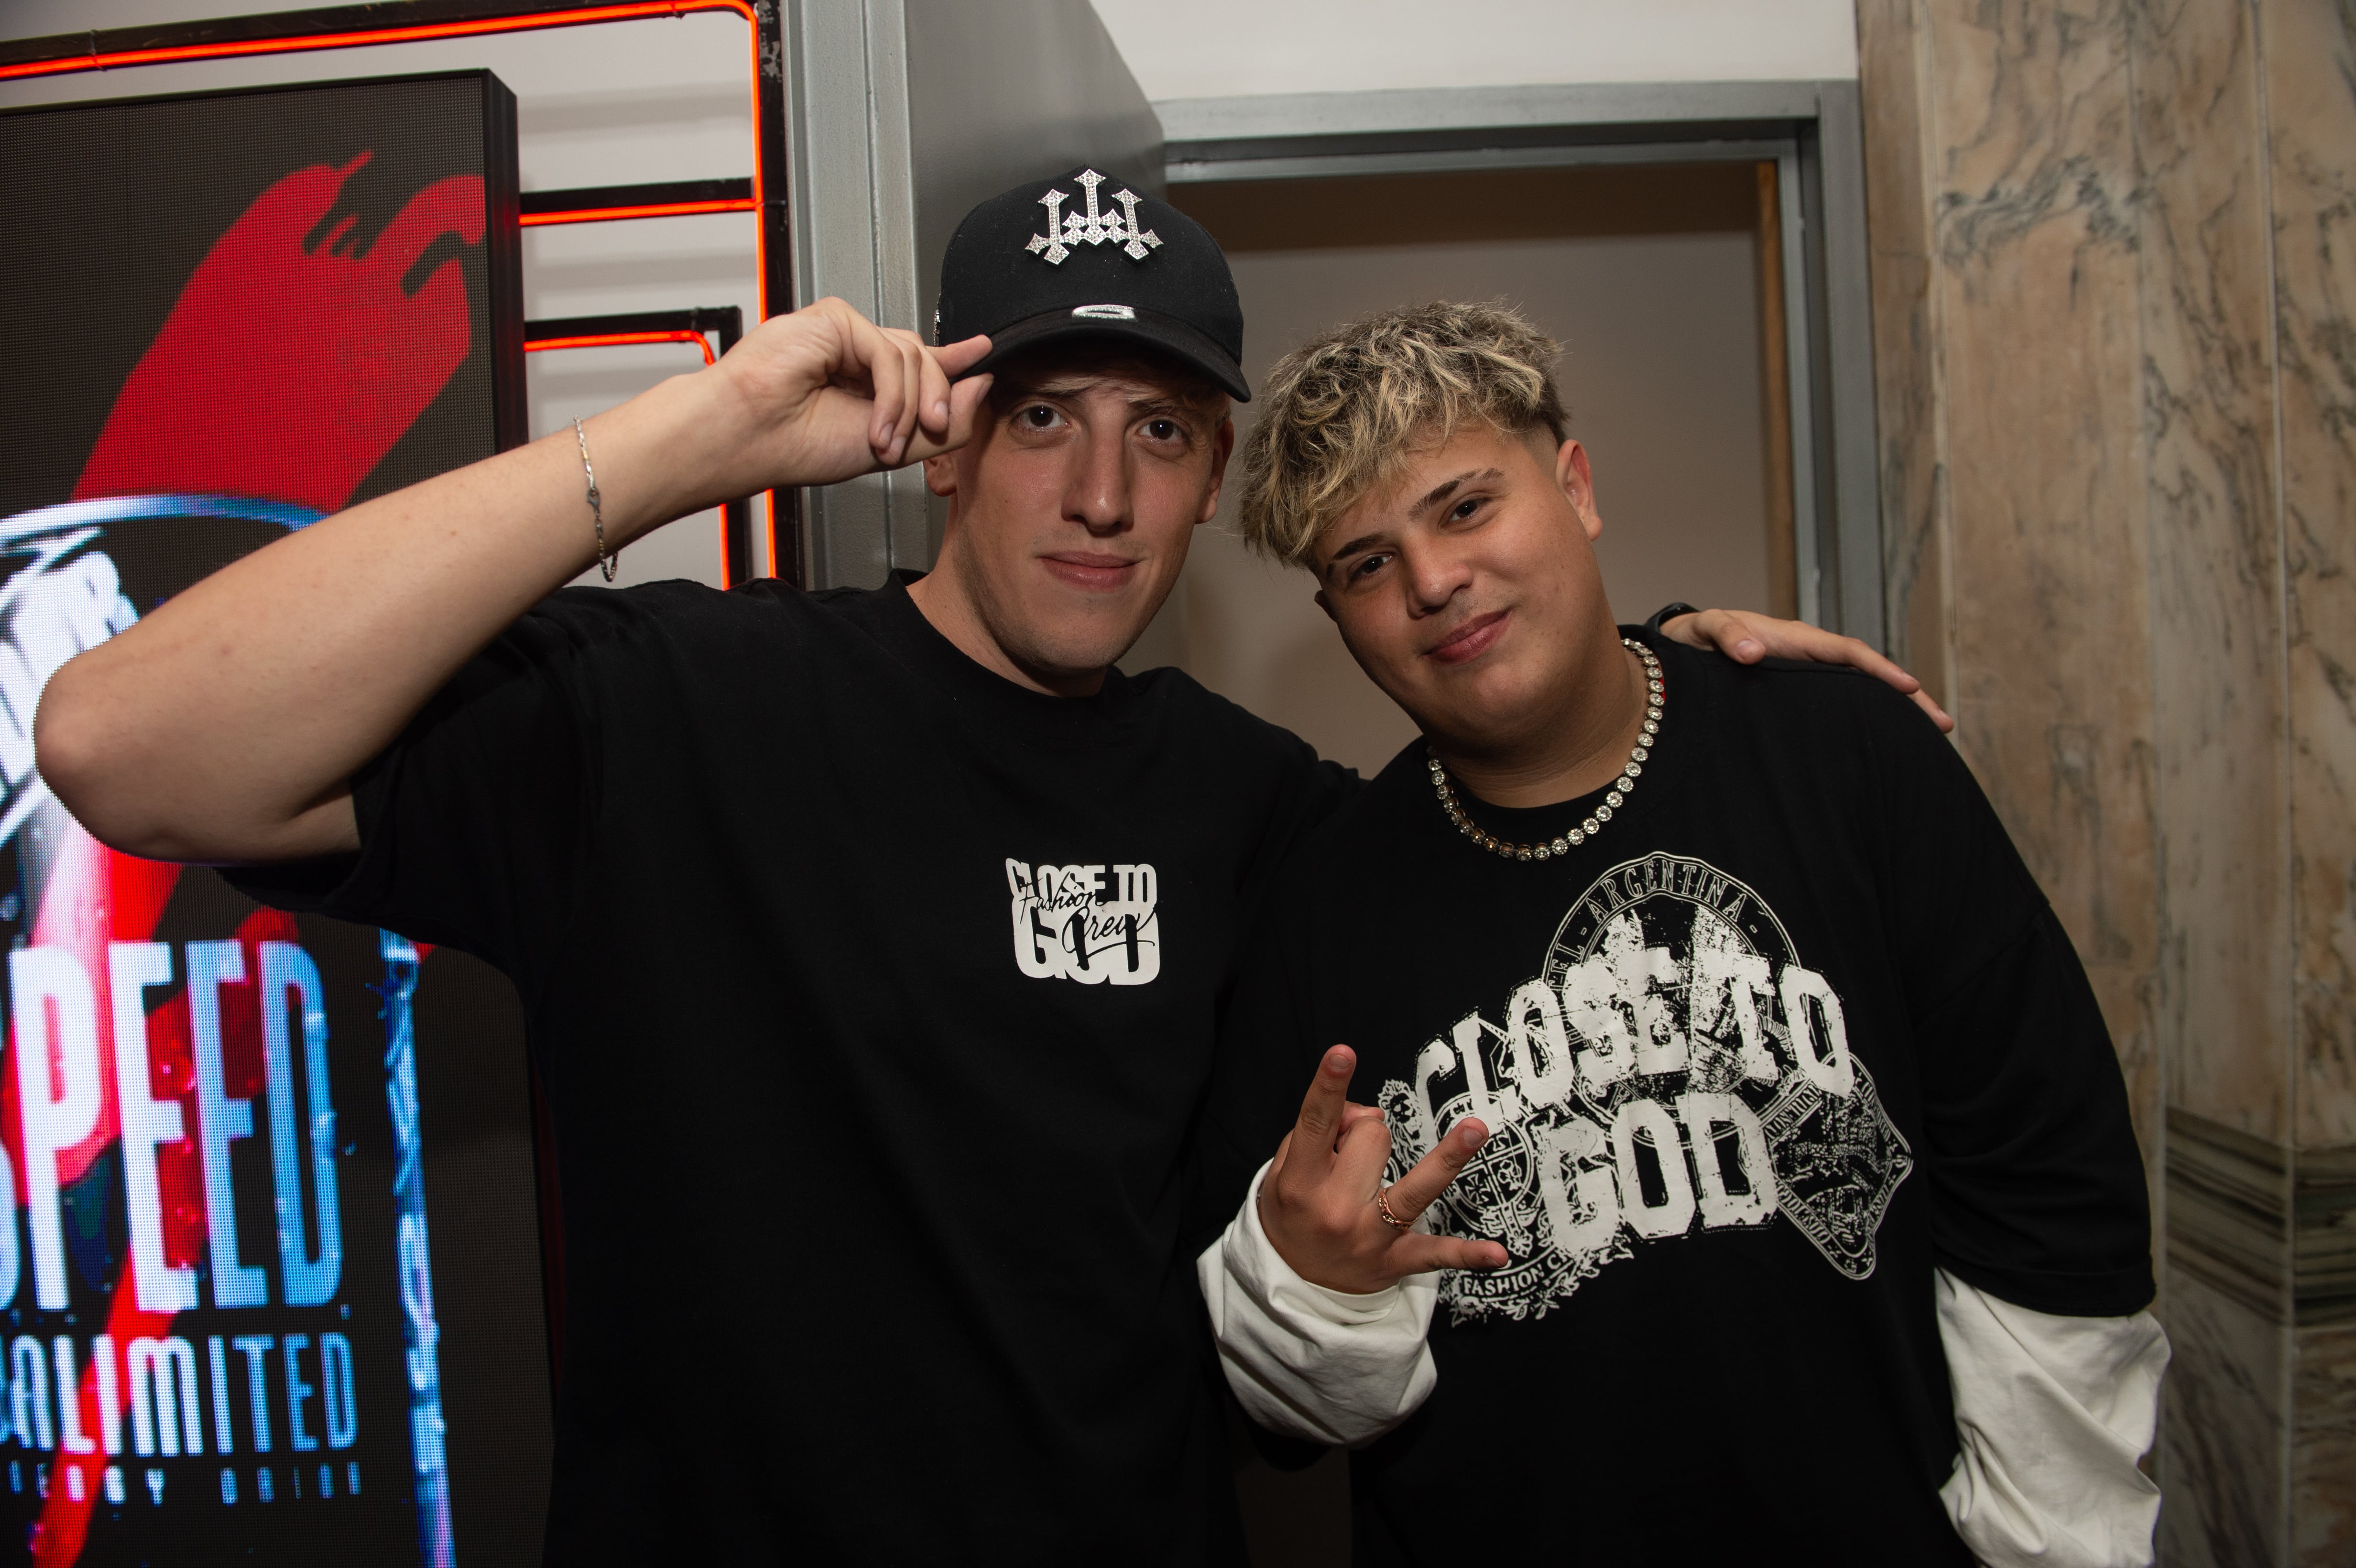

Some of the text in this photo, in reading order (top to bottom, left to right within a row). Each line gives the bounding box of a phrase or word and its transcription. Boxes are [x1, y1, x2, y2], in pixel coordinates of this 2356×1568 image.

[1005, 858, 1157, 906] CLOSE TO
[1585, 860, 1747, 924] ARGENTINA
[1012, 895, 1160, 985] GOD
[1415, 947, 1855, 1145] CLOSE TO
[0, 940, 343, 1313] PEED
[1531, 1092, 1778, 1257] GOD
[1463, 1263, 1546, 1296] FASHION
